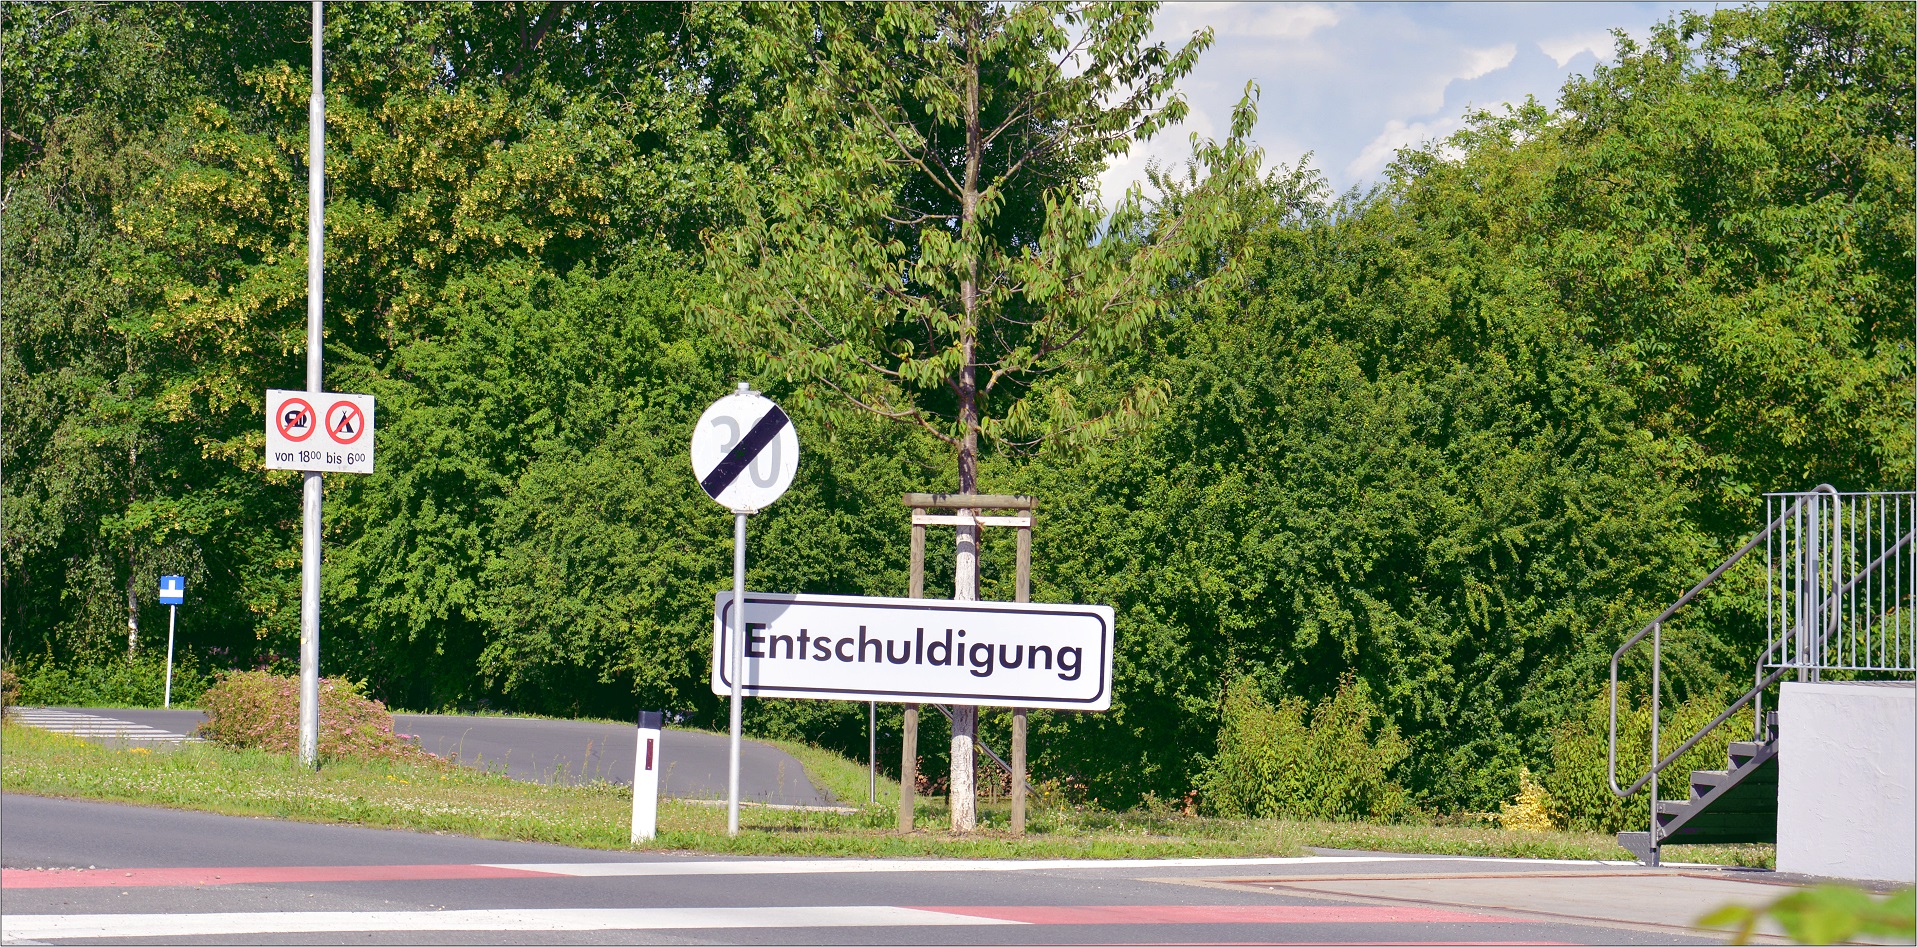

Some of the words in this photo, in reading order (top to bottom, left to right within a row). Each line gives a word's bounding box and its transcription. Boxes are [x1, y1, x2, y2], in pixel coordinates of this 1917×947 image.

[275, 452, 294, 462] von
[326, 452, 342, 465] bis
[711, 415, 781, 489] 30
[744, 622, 1083, 681] Entschuldigung
